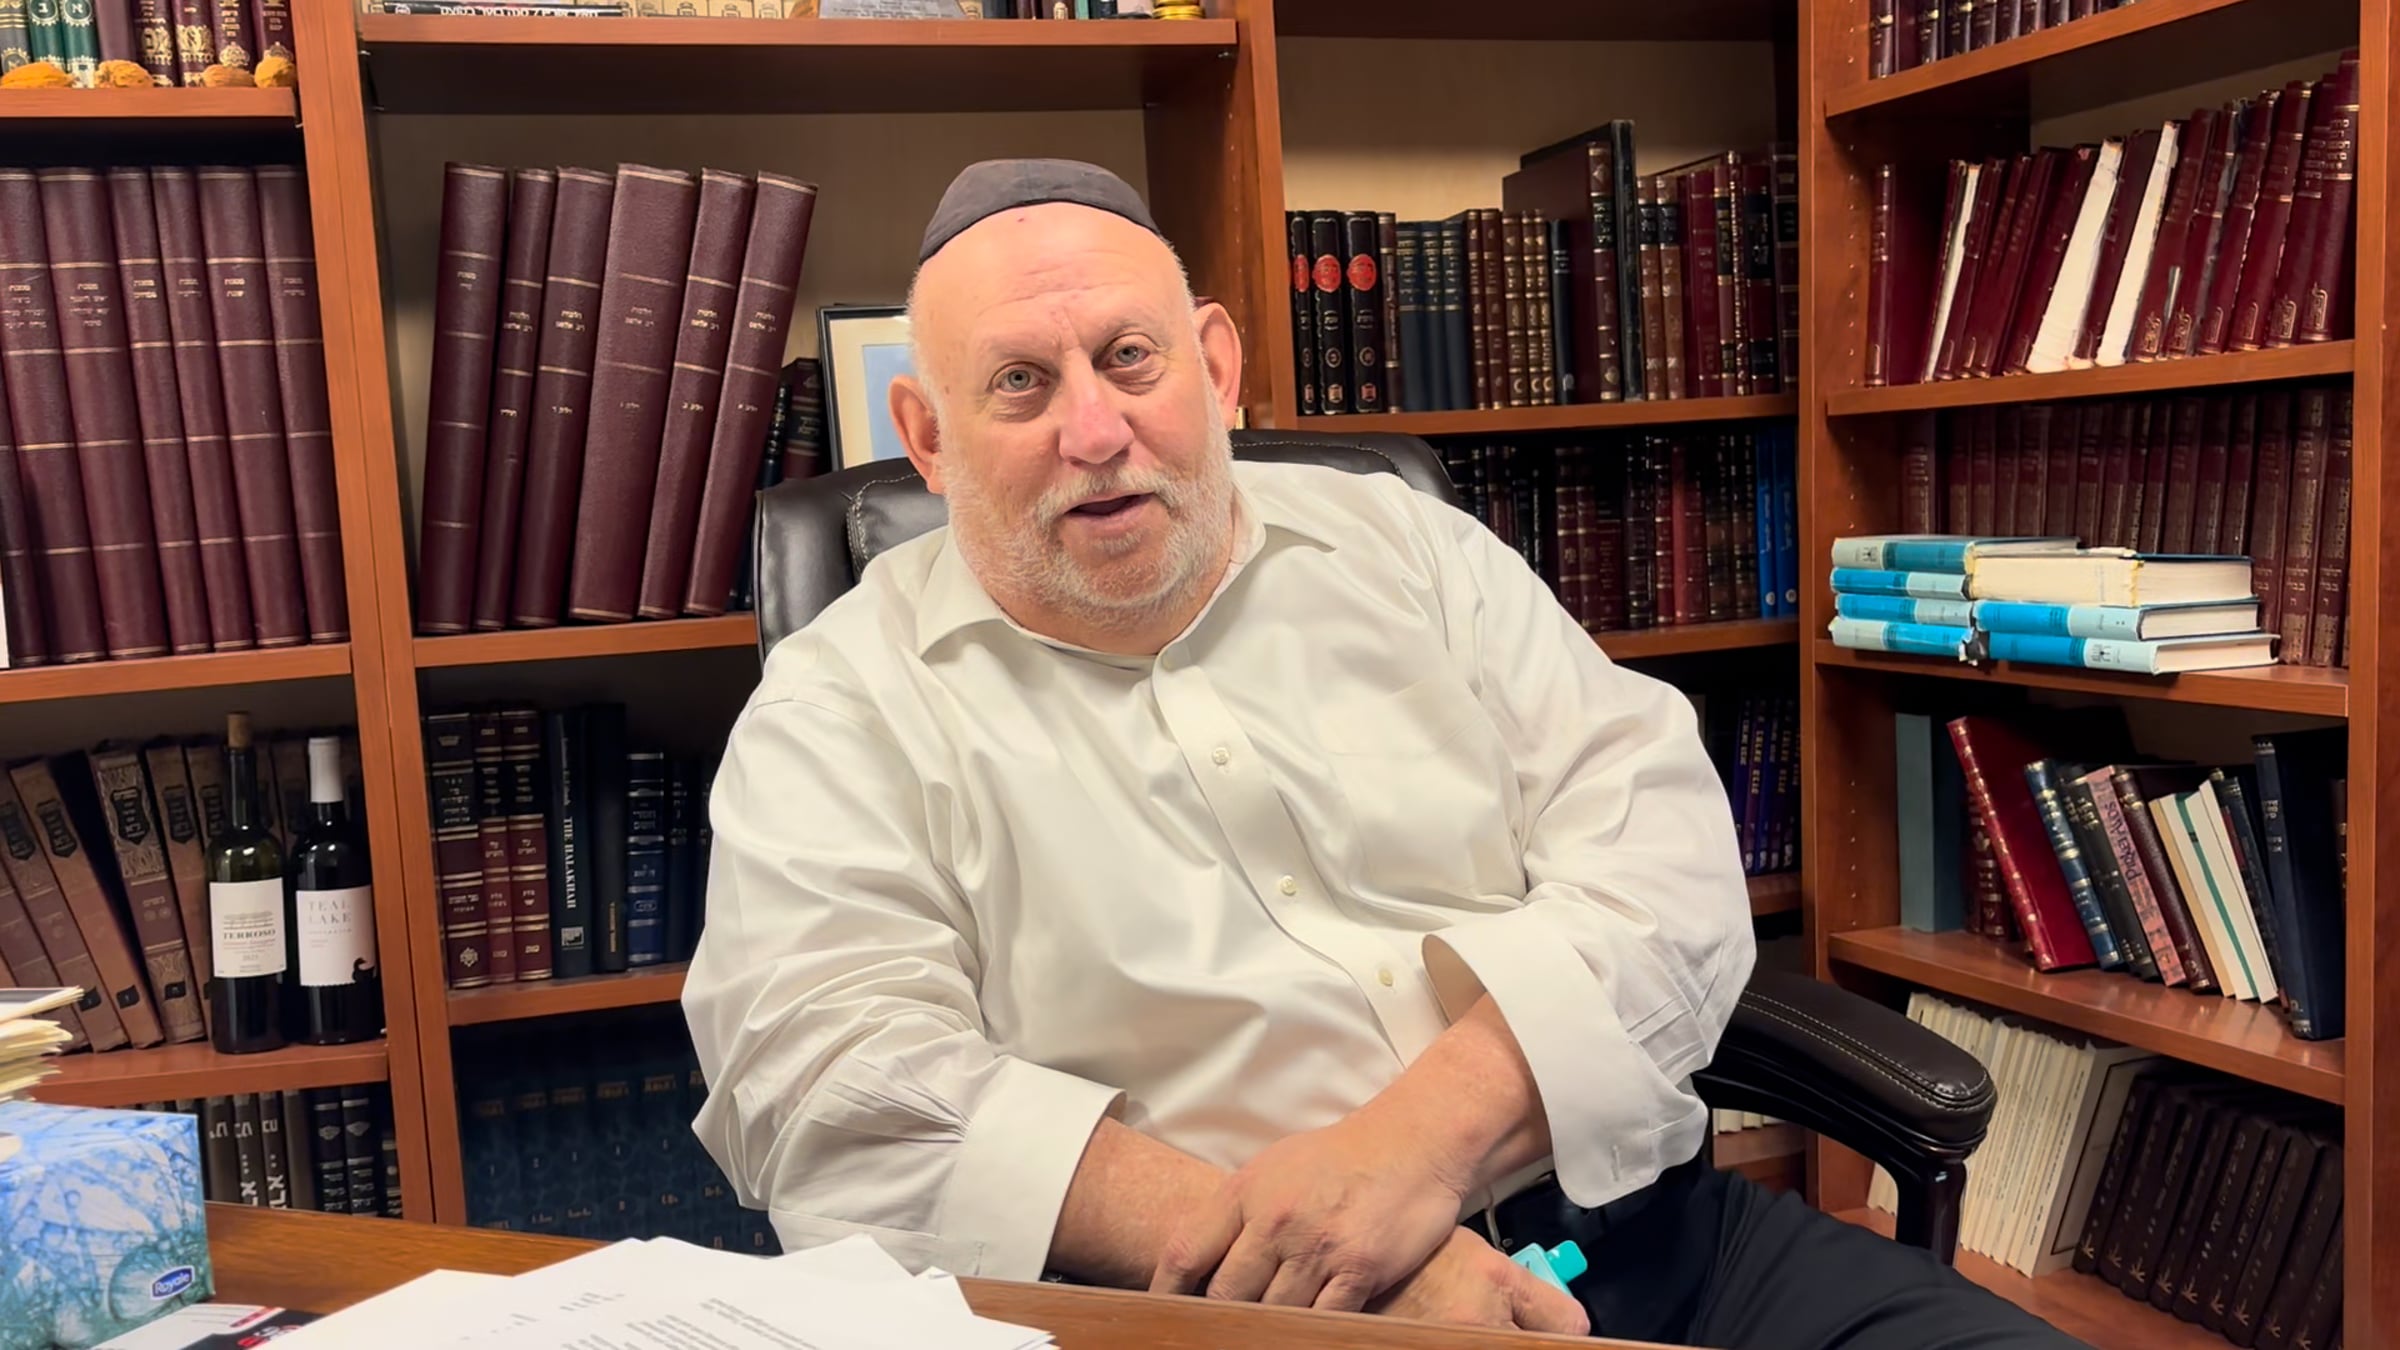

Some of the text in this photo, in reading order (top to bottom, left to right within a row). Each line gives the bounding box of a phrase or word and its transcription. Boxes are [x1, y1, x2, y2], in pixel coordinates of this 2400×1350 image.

[71, 3, 84, 14] א
[563, 816, 574, 841] THE
[564, 843, 576, 909] HALAKHAH
[308, 898, 351, 911] TEAL
[308, 912, 352, 924] LAKE
[223, 929, 276, 940] TERROSO
[154, 1273, 190, 1294] Royale
